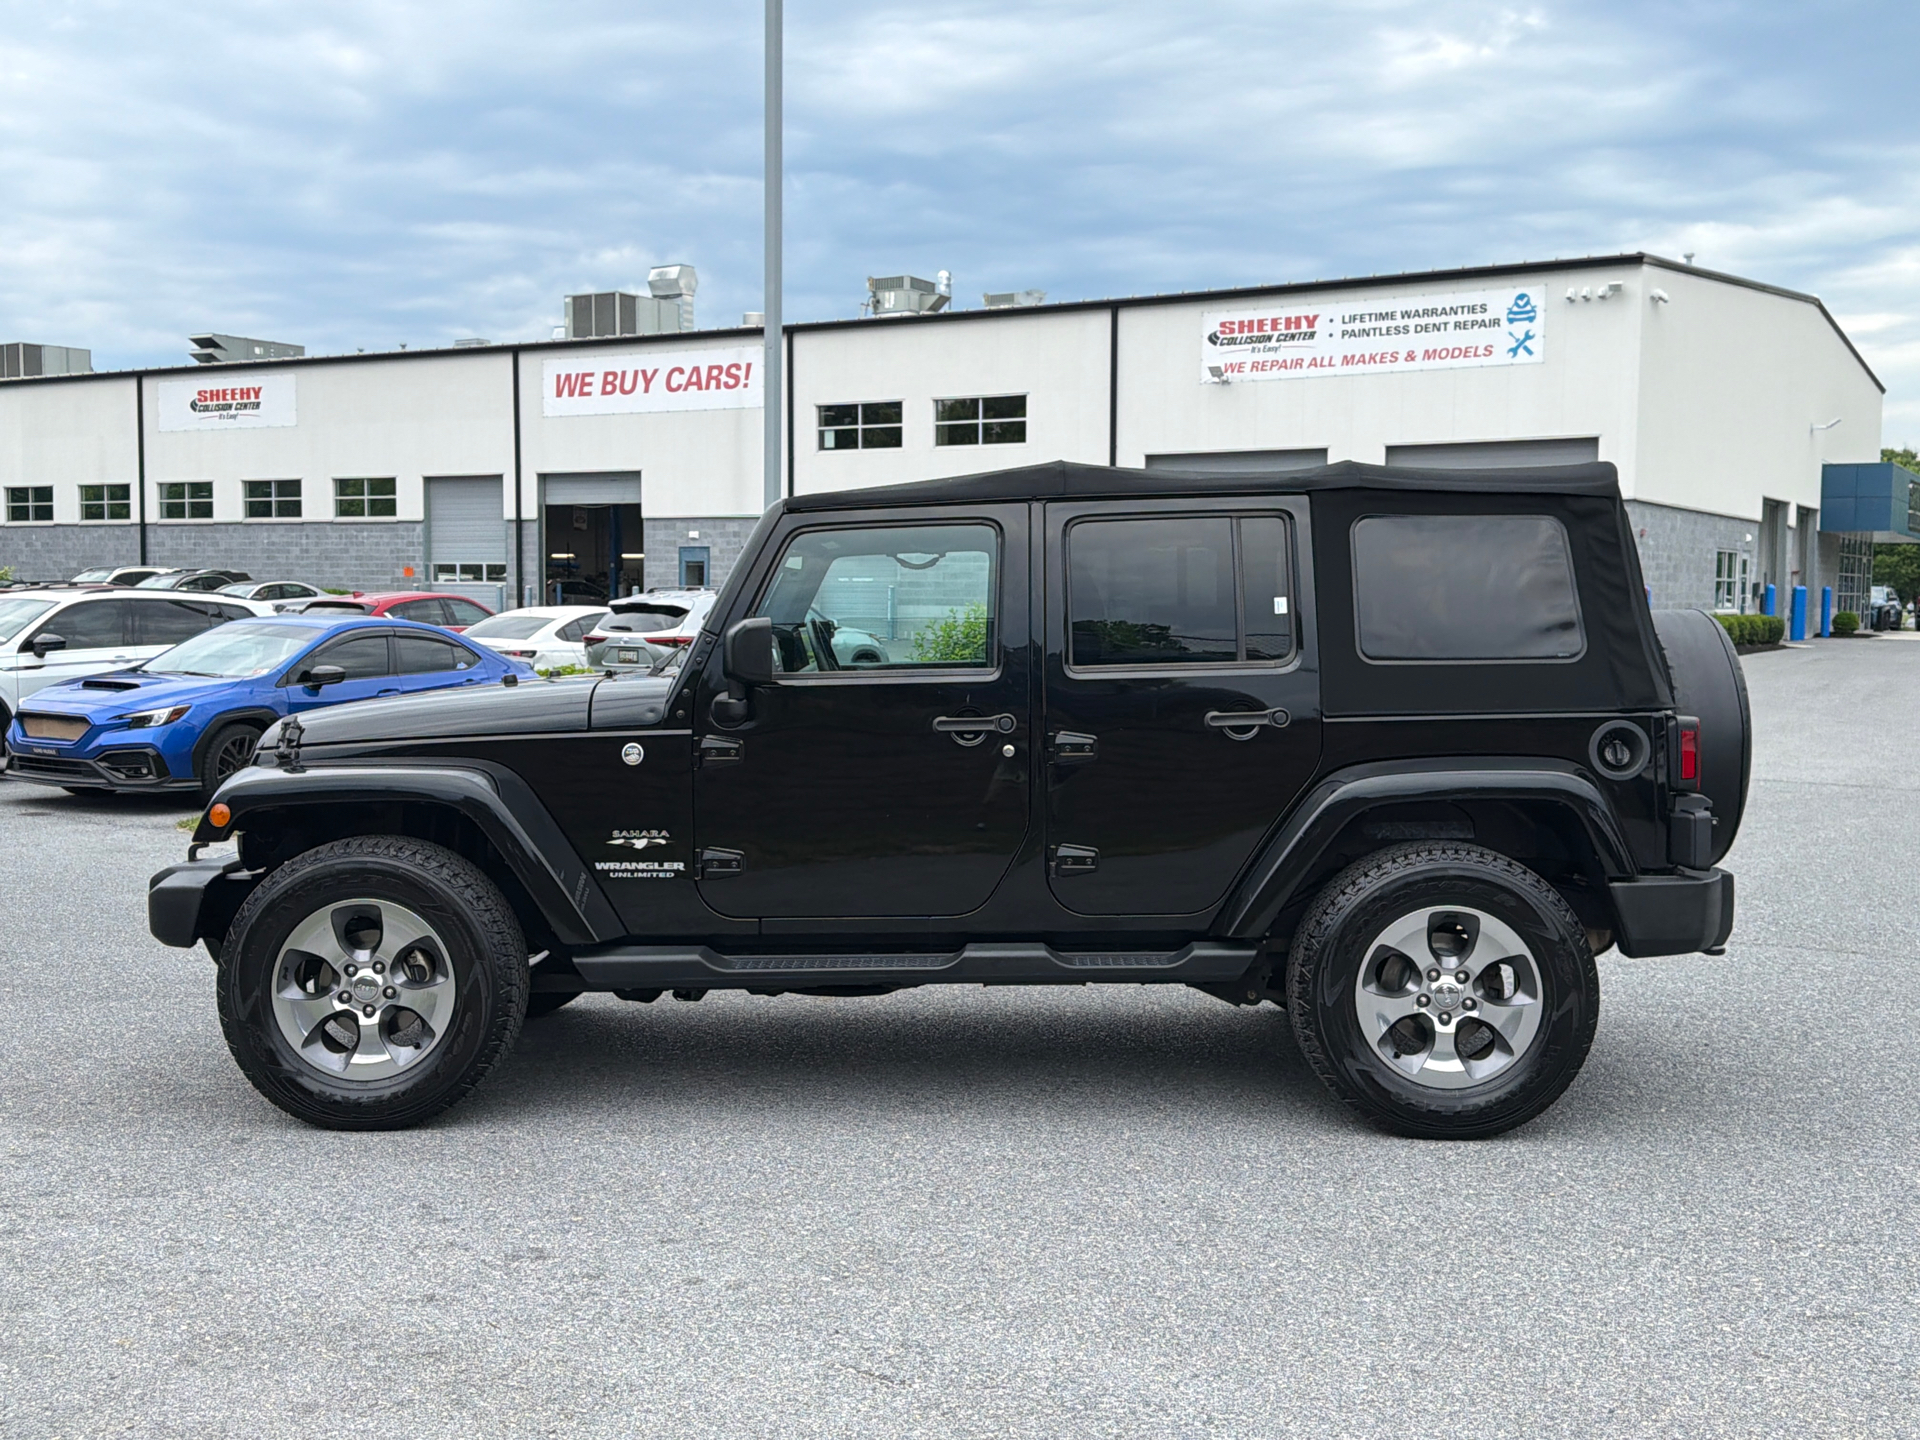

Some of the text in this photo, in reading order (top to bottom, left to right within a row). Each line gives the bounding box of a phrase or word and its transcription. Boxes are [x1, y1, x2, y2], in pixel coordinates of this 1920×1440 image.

[1341, 303, 1488, 324] LIFETIME WARRANTIES
[1219, 314, 1320, 334] SHEEHY
[1341, 318, 1501, 340] PAINTLESS DENT REPAIR
[1219, 330, 1317, 346] COLLISION CENTER
[1251, 345, 1261, 354] It's
[1224, 345, 1494, 374] WE REPAIR ALL MAKES & MODELS
[556, 362, 752, 397] WE BUY CARS!
[197, 387, 262, 402] SHEEHY
[198, 401, 261, 412] COLLISION CENTER
[612, 830, 670, 838] SAHARA
[594, 861, 686, 871] WRANGLER
